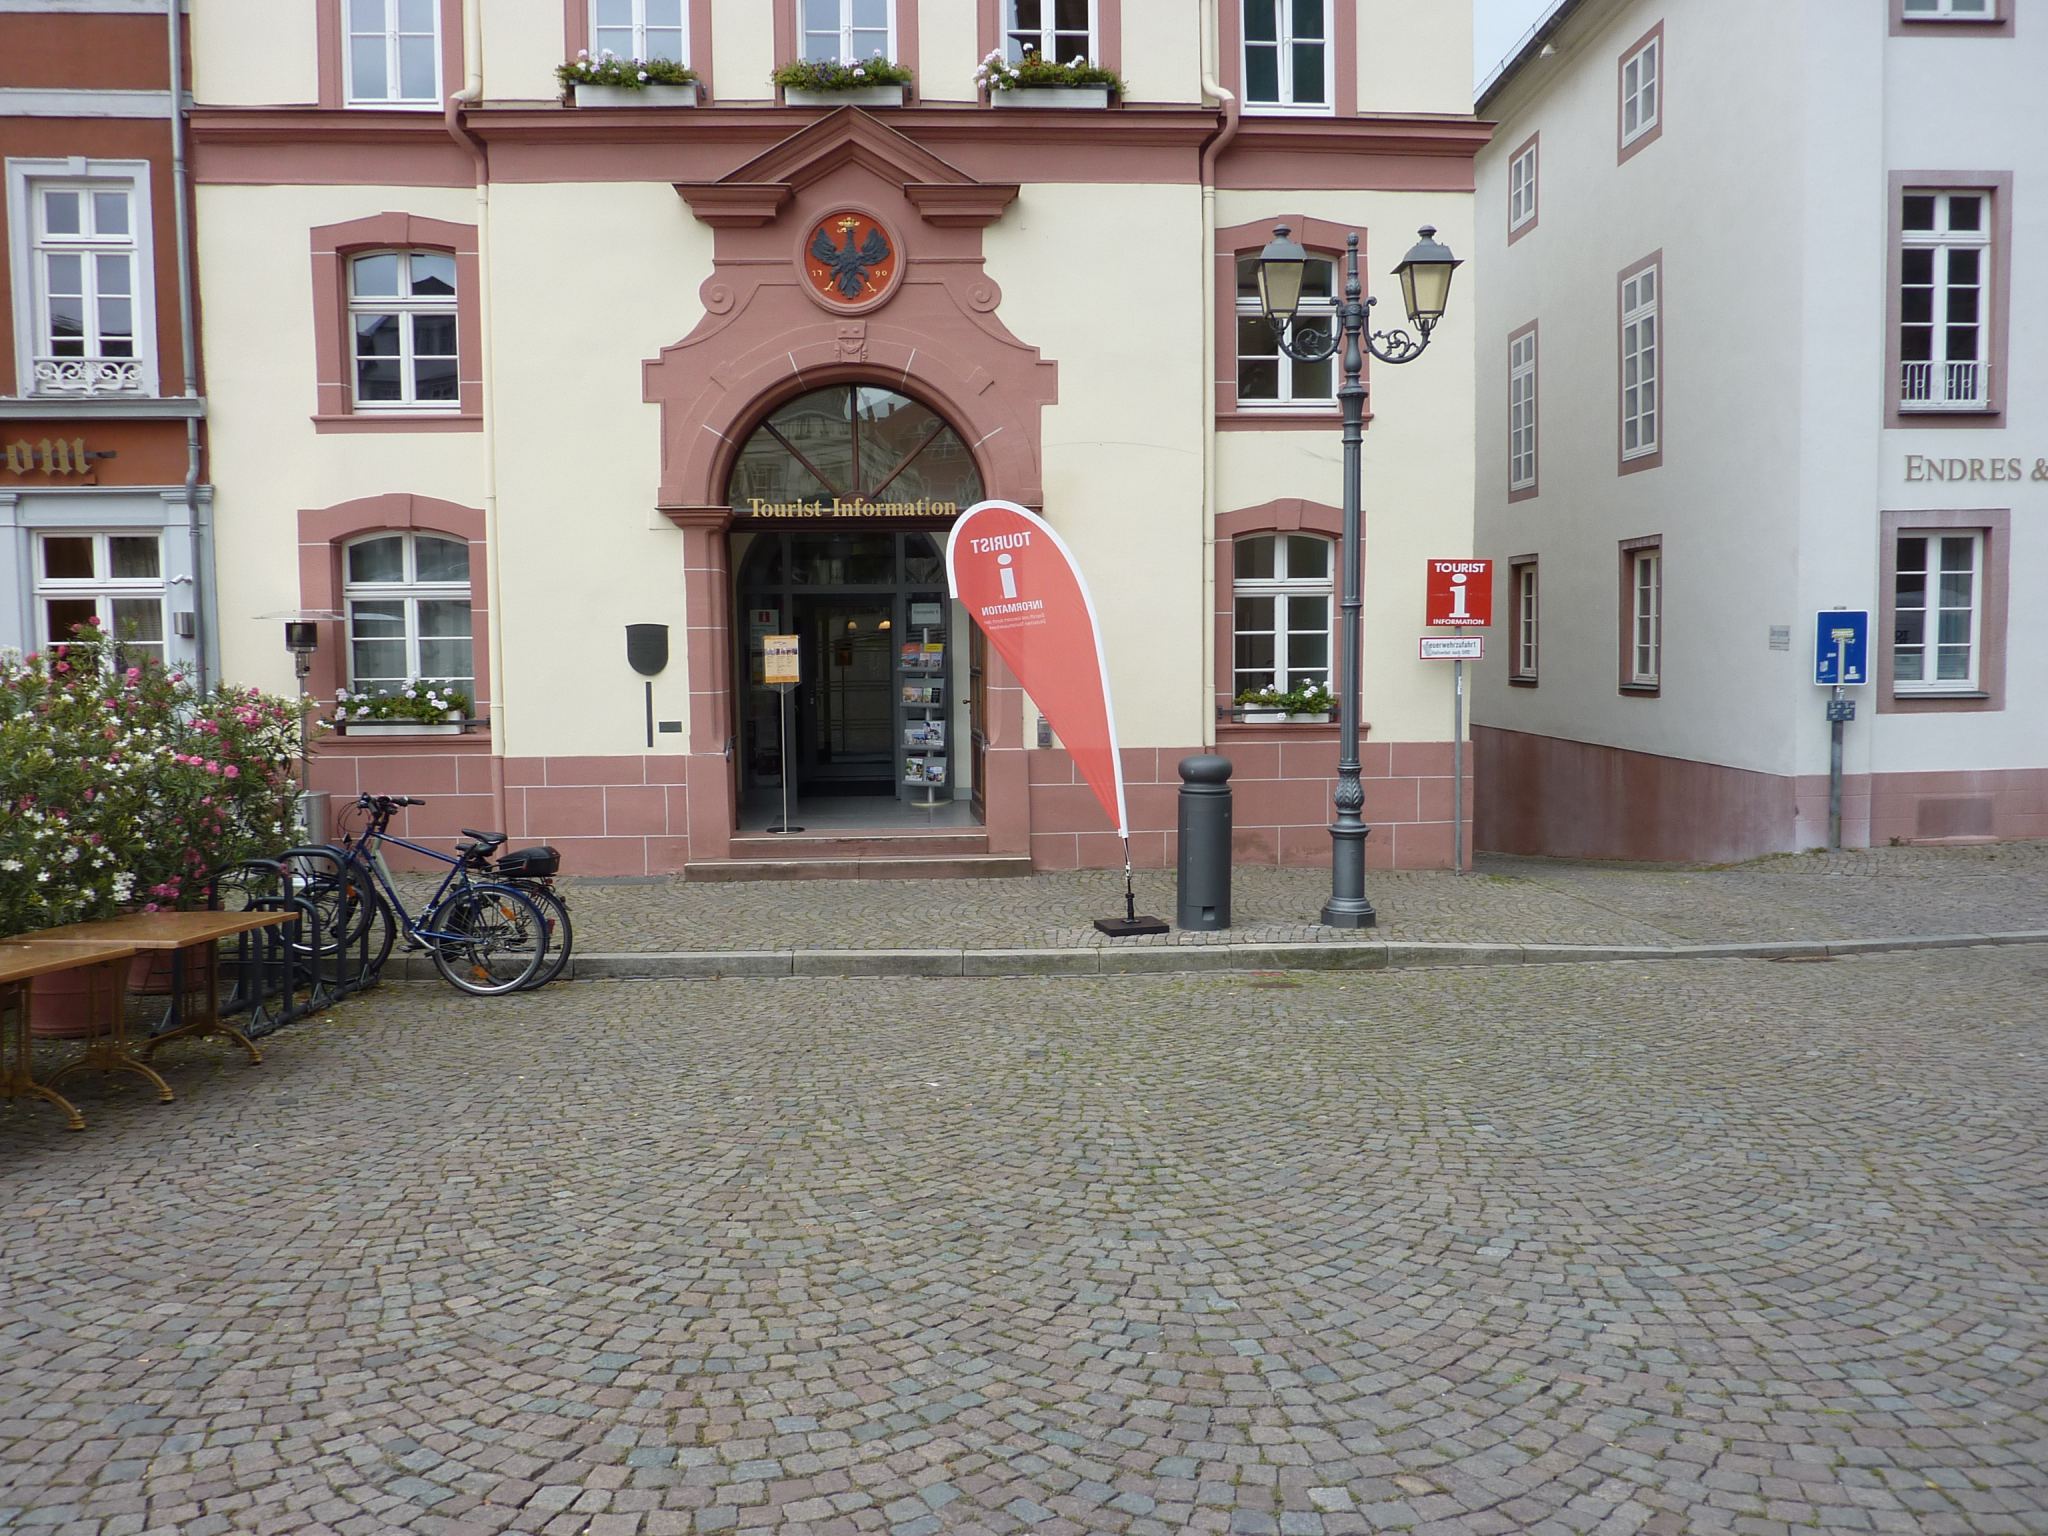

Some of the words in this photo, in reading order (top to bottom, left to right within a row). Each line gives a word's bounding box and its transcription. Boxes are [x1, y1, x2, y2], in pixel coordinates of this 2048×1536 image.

[1904, 454, 2022, 482] ENDRES
[747, 497, 957, 518] Tourist-Information
[1434, 562, 1486, 573] TOURIST
